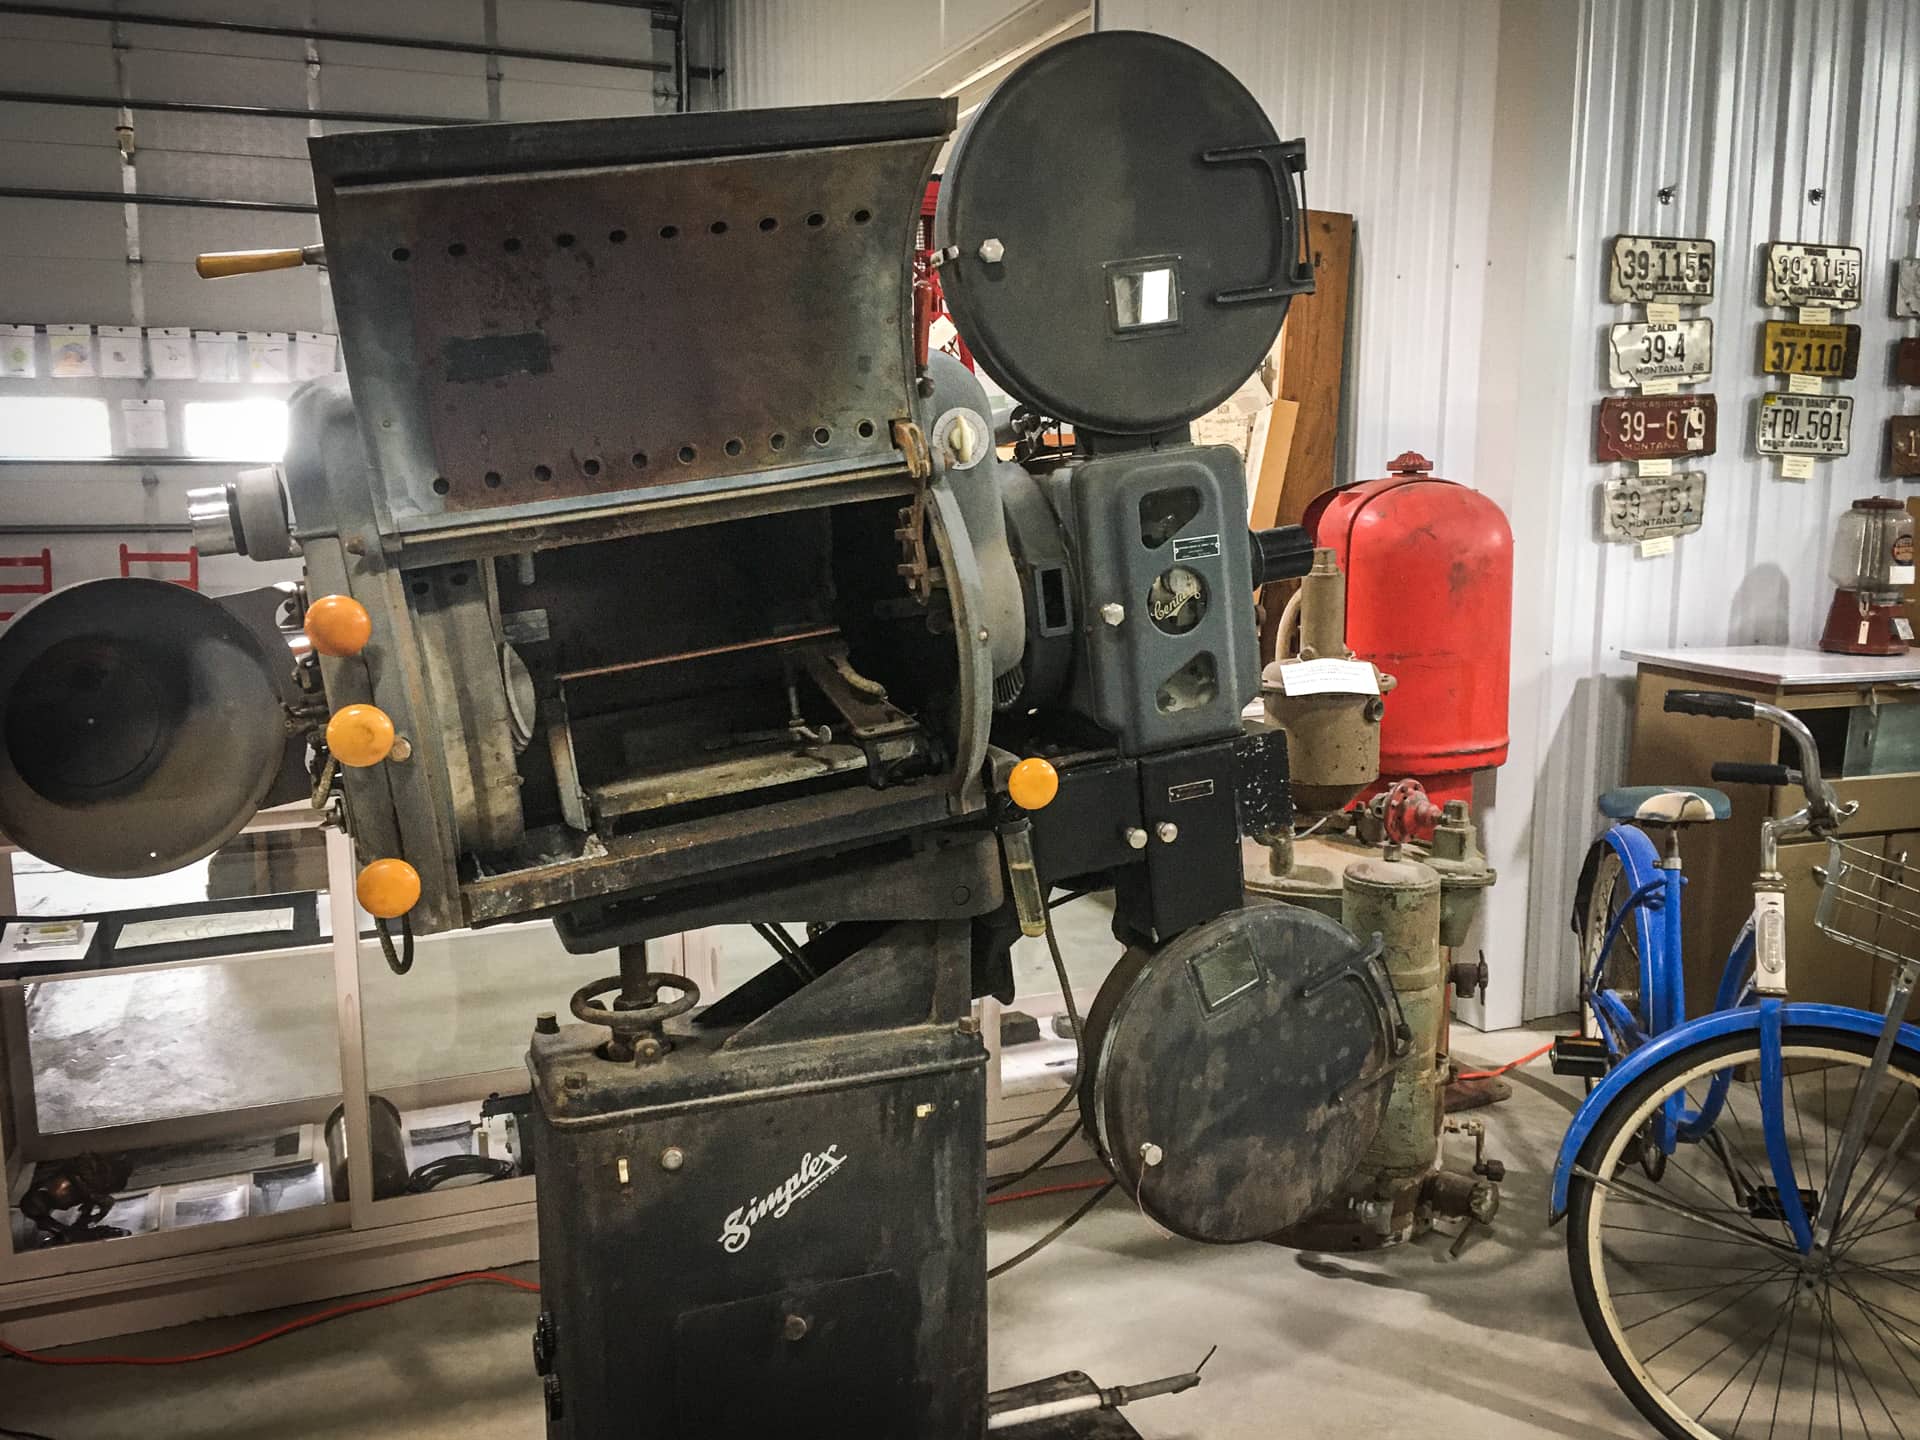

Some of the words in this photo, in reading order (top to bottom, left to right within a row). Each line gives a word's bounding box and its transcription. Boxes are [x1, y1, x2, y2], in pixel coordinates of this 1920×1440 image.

[1637, 282, 1688, 292] MONTANA
[1789, 286, 1837, 297] MONTANA
[1646, 323, 1677, 333] DEALER
[1635, 364, 1684, 376] MONTANA
[1771, 408, 1842, 441] TBL581
[1624, 441, 1680, 451] MONTANA
[1790, 441, 1818, 449] GARDEN
[1628, 517, 1677, 528] MONTANA
[717, 1144, 847, 1253] Simplex
